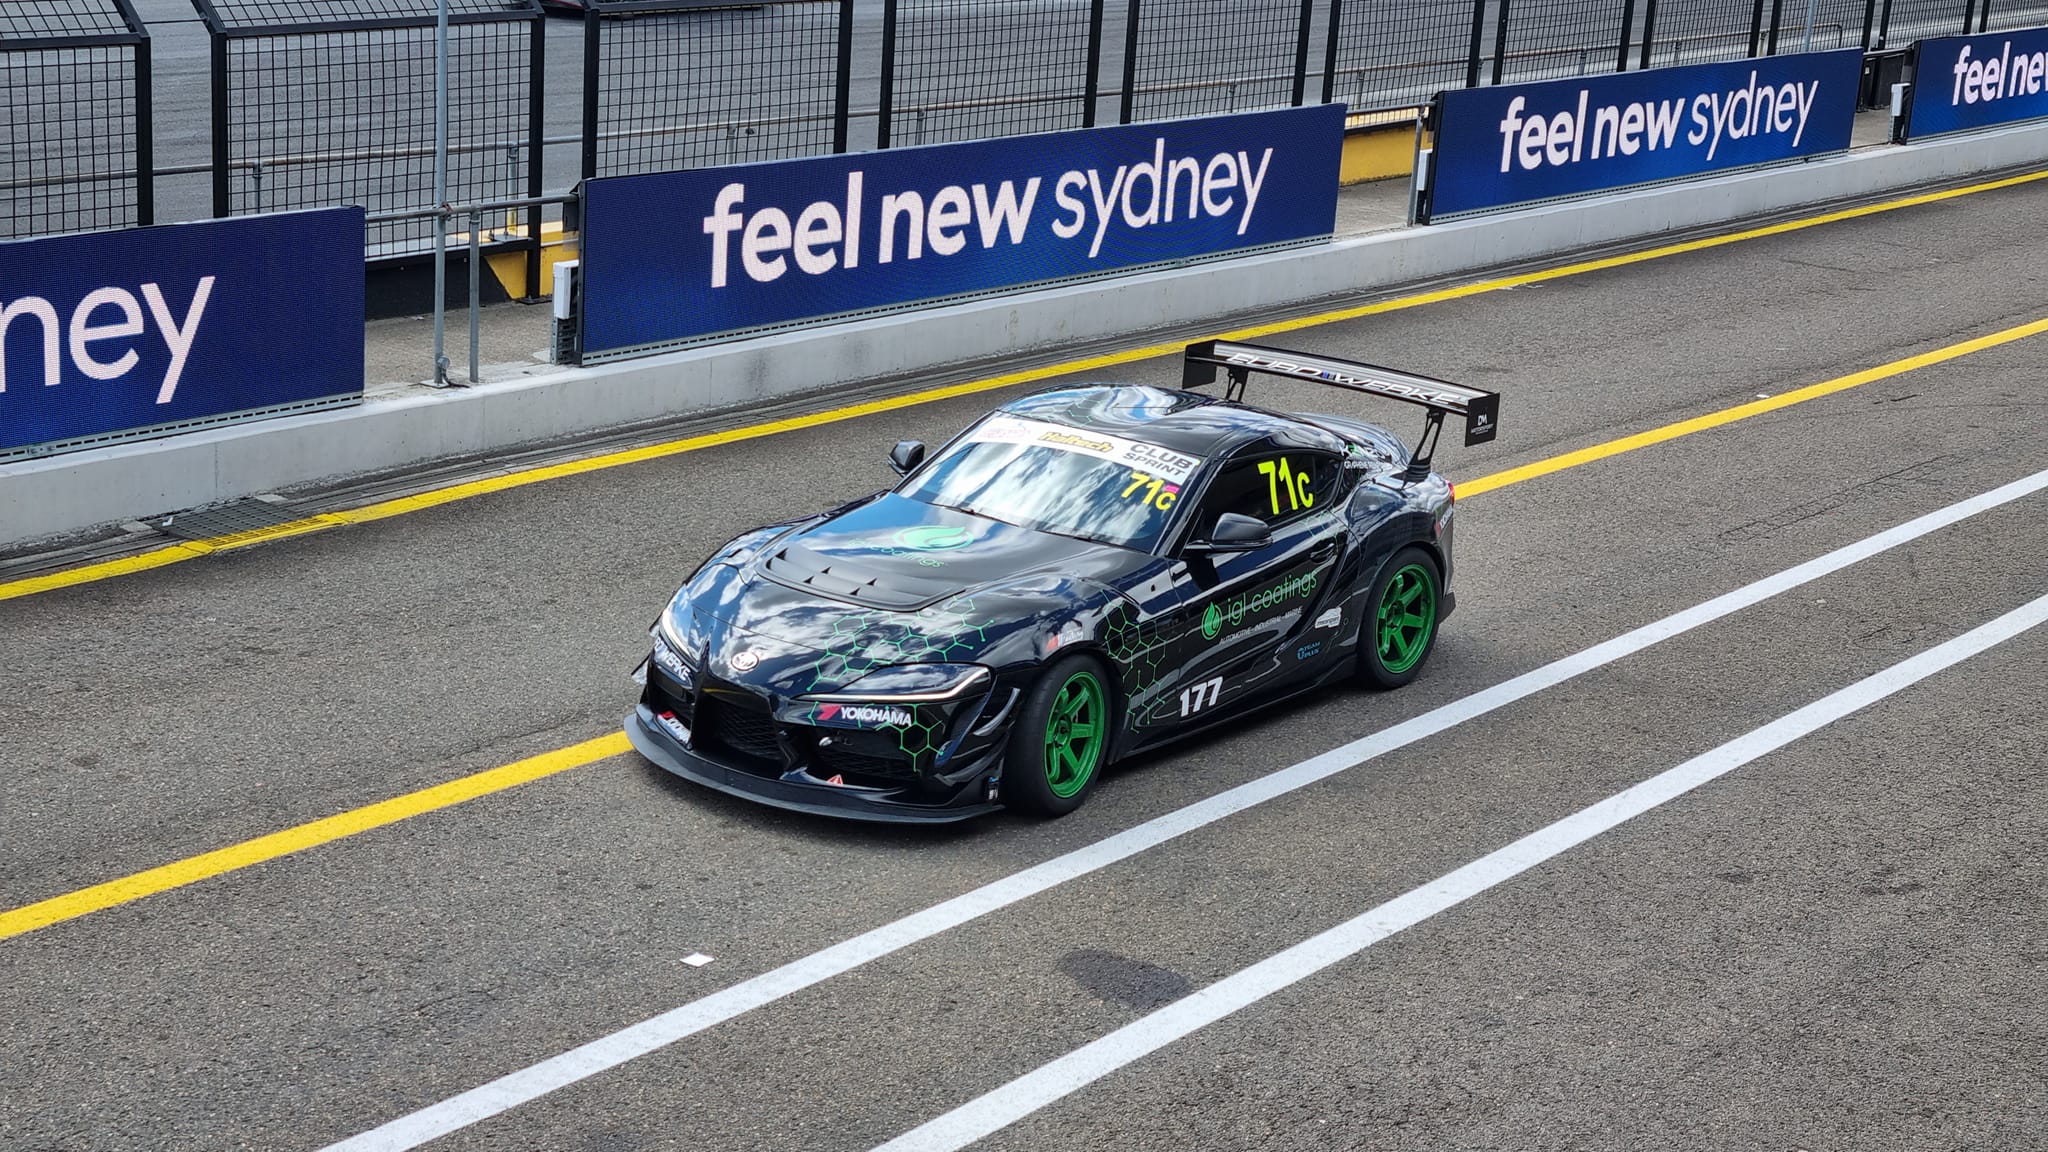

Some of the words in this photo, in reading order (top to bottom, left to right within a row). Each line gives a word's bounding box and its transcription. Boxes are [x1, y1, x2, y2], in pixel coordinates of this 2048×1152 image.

[1952, 41, 2011, 106] feel
[1500, 90, 1589, 172] feel
[1590, 98, 1686, 159] new
[1687, 70, 1819, 161] sydney
[703, 171, 864, 288] feel
[878, 177, 1042, 264] new
[1051, 138, 1274, 258] sydney
[1226, 352, 1323, 377] EURO
[1334, 372, 1459, 405] WERKE
[1122, 452, 1186, 476] SPRINT
[1129, 443, 1193, 469] CLUB
[1226, 591, 1247, 626] igl
[1250, 570, 1317, 613] coatings
[840, 706, 912, 727] YOKOHAMA
[1180, 676, 1224, 717] 177
